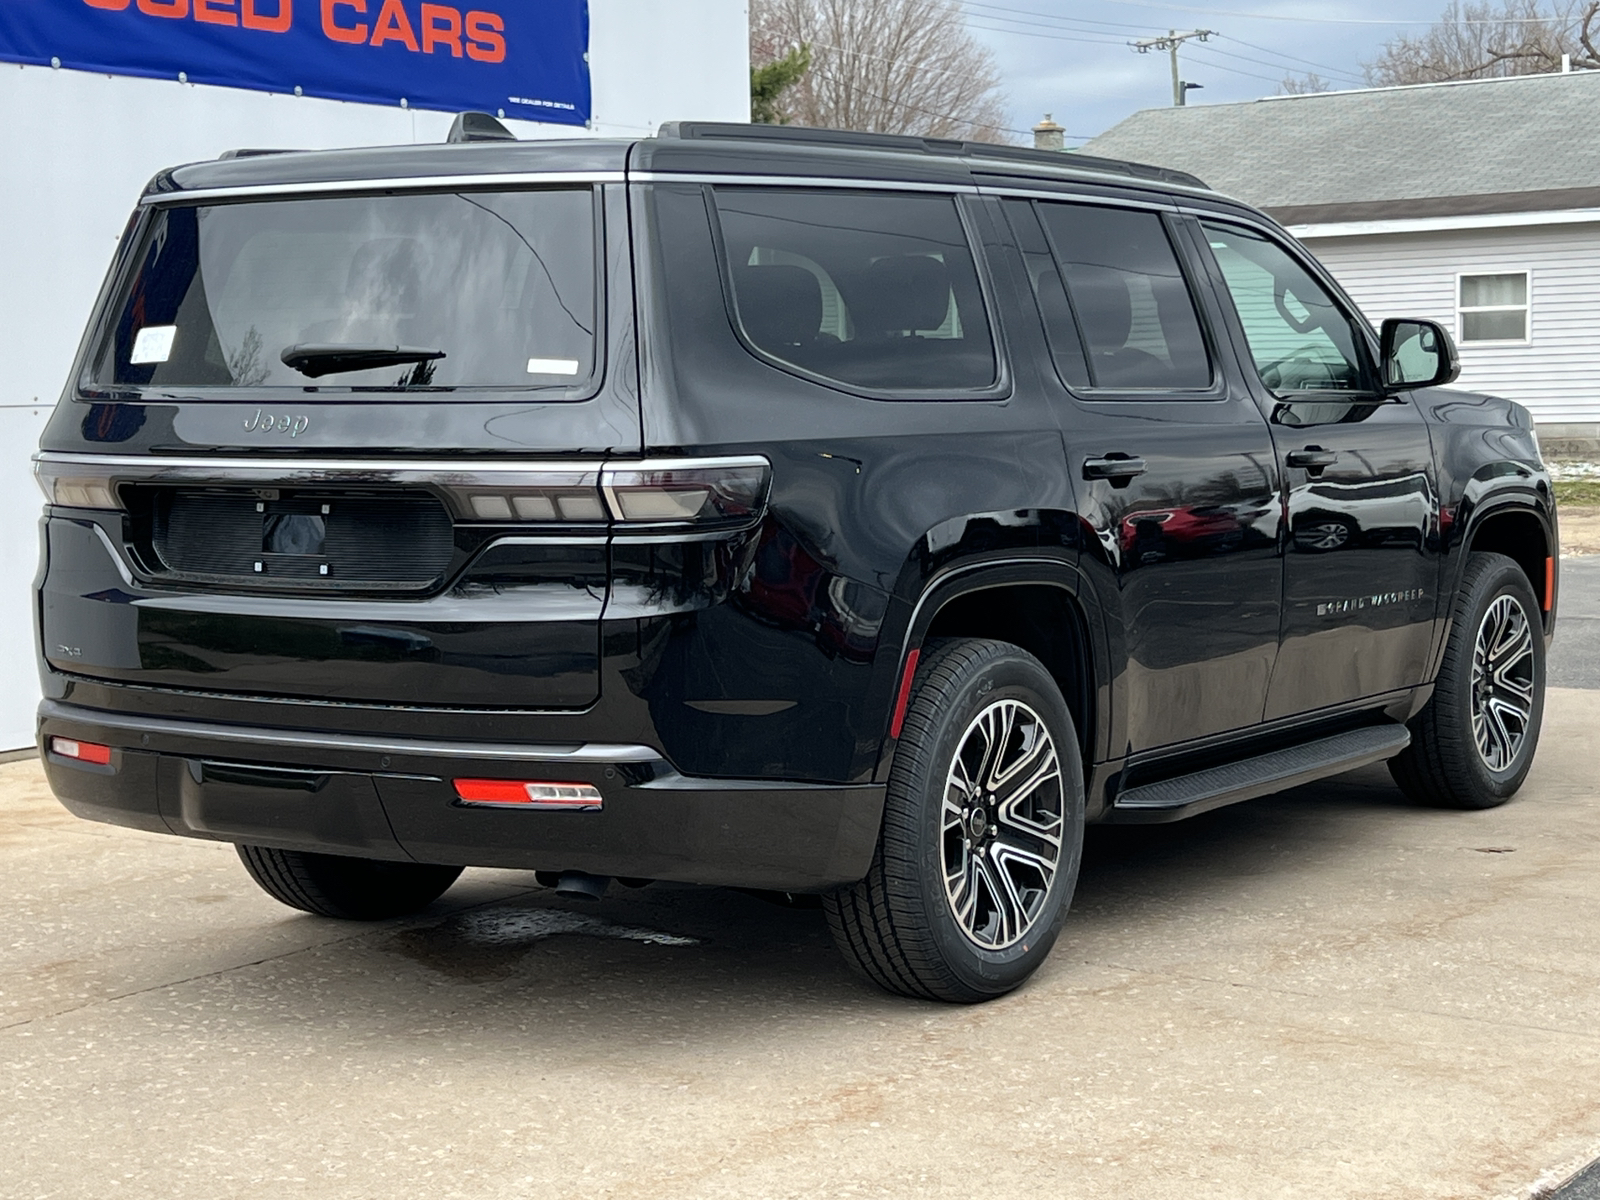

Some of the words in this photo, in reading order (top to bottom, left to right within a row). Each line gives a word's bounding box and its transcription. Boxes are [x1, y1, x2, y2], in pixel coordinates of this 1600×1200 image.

[83, 0, 292, 33] ED
[321, 0, 506, 63] CARS
[243, 408, 309, 438] Jeep
